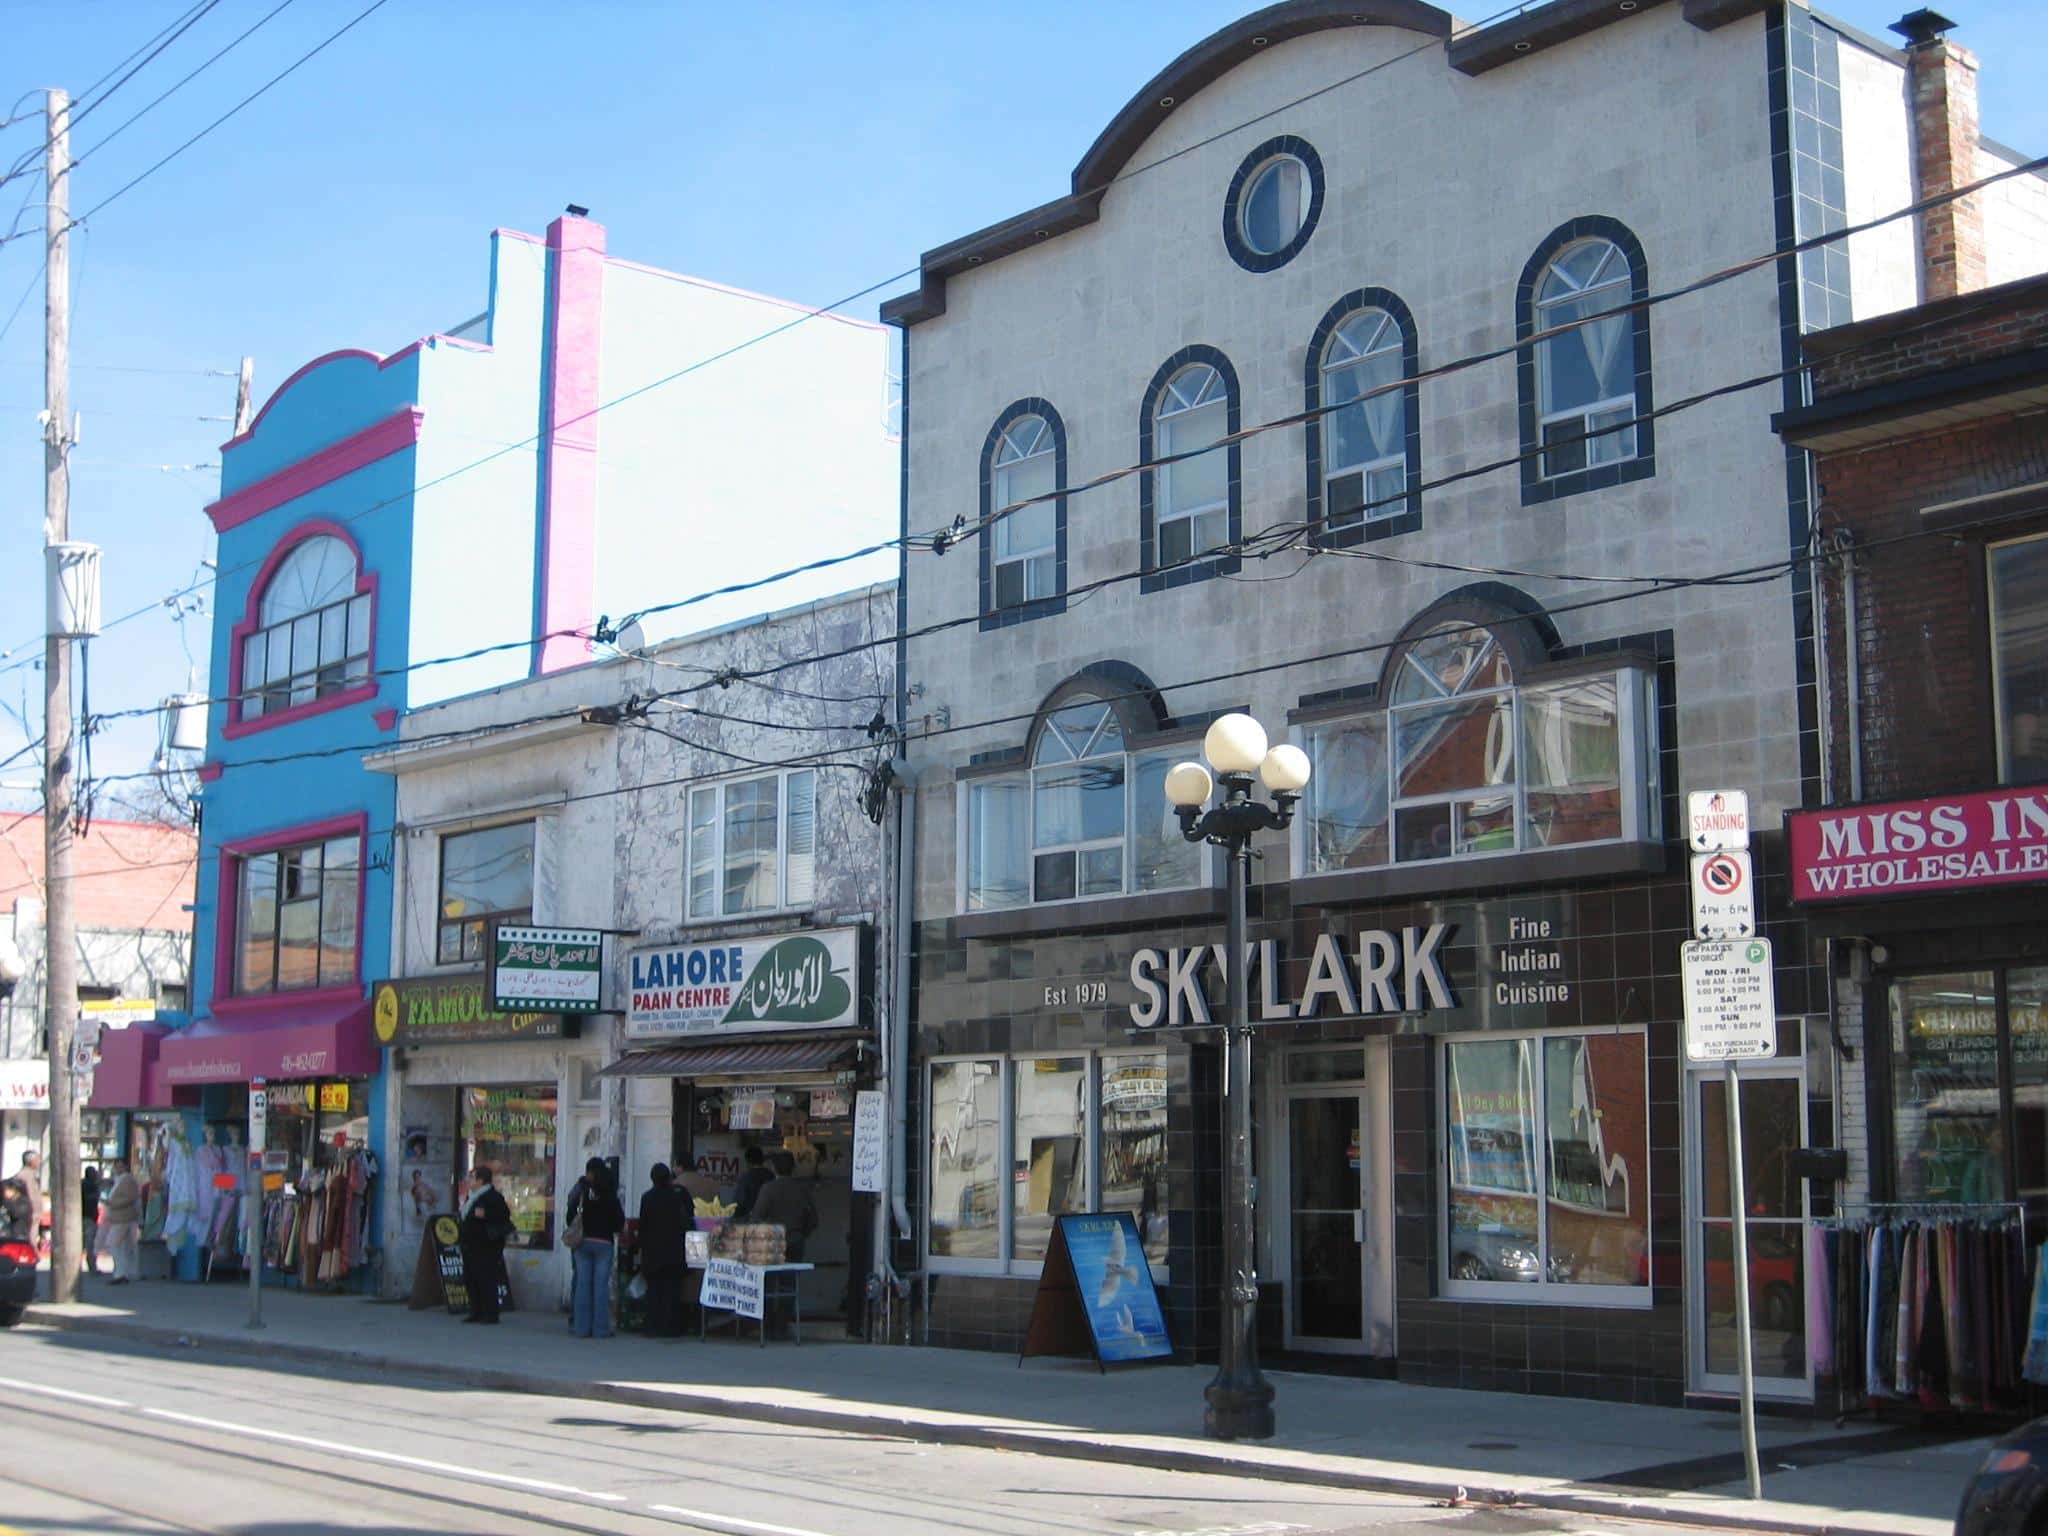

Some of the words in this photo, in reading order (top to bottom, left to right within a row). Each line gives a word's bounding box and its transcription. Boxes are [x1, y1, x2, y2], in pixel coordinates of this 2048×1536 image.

[1710, 797, 1725, 813] NO
[1693, 813, 1745, 832] STANDING
[1817, 804, 1968, 861] MISS
[1805, 844, 2048, 893] WHOLESALE
[1509, 916, 1551, 940] Fine
[631, 946, 744, 990] LAHORE
[1500, 947, 1561, 973] Indian
[1704, 968, 1728, 976] MON
[1735, 967, 1751, 975] FRI
[1748, 975, 1761, 983] PM
[632, 991, 673, 1012] PAAN
[675, 986, 731, 1009] CENTRE
[1044, 986, 1067, 1007] Est
[1075, 982, 1107, 1004] 1979
[1495, 980, 1569, 1005] Cuisine
[1720, 995, 1738, 1004] SAT
[1720, 1014, 1740, 1022] SUN
[696, 1155, 740, 1174] ATM
[736, 1299, 757, 1315] TIME
